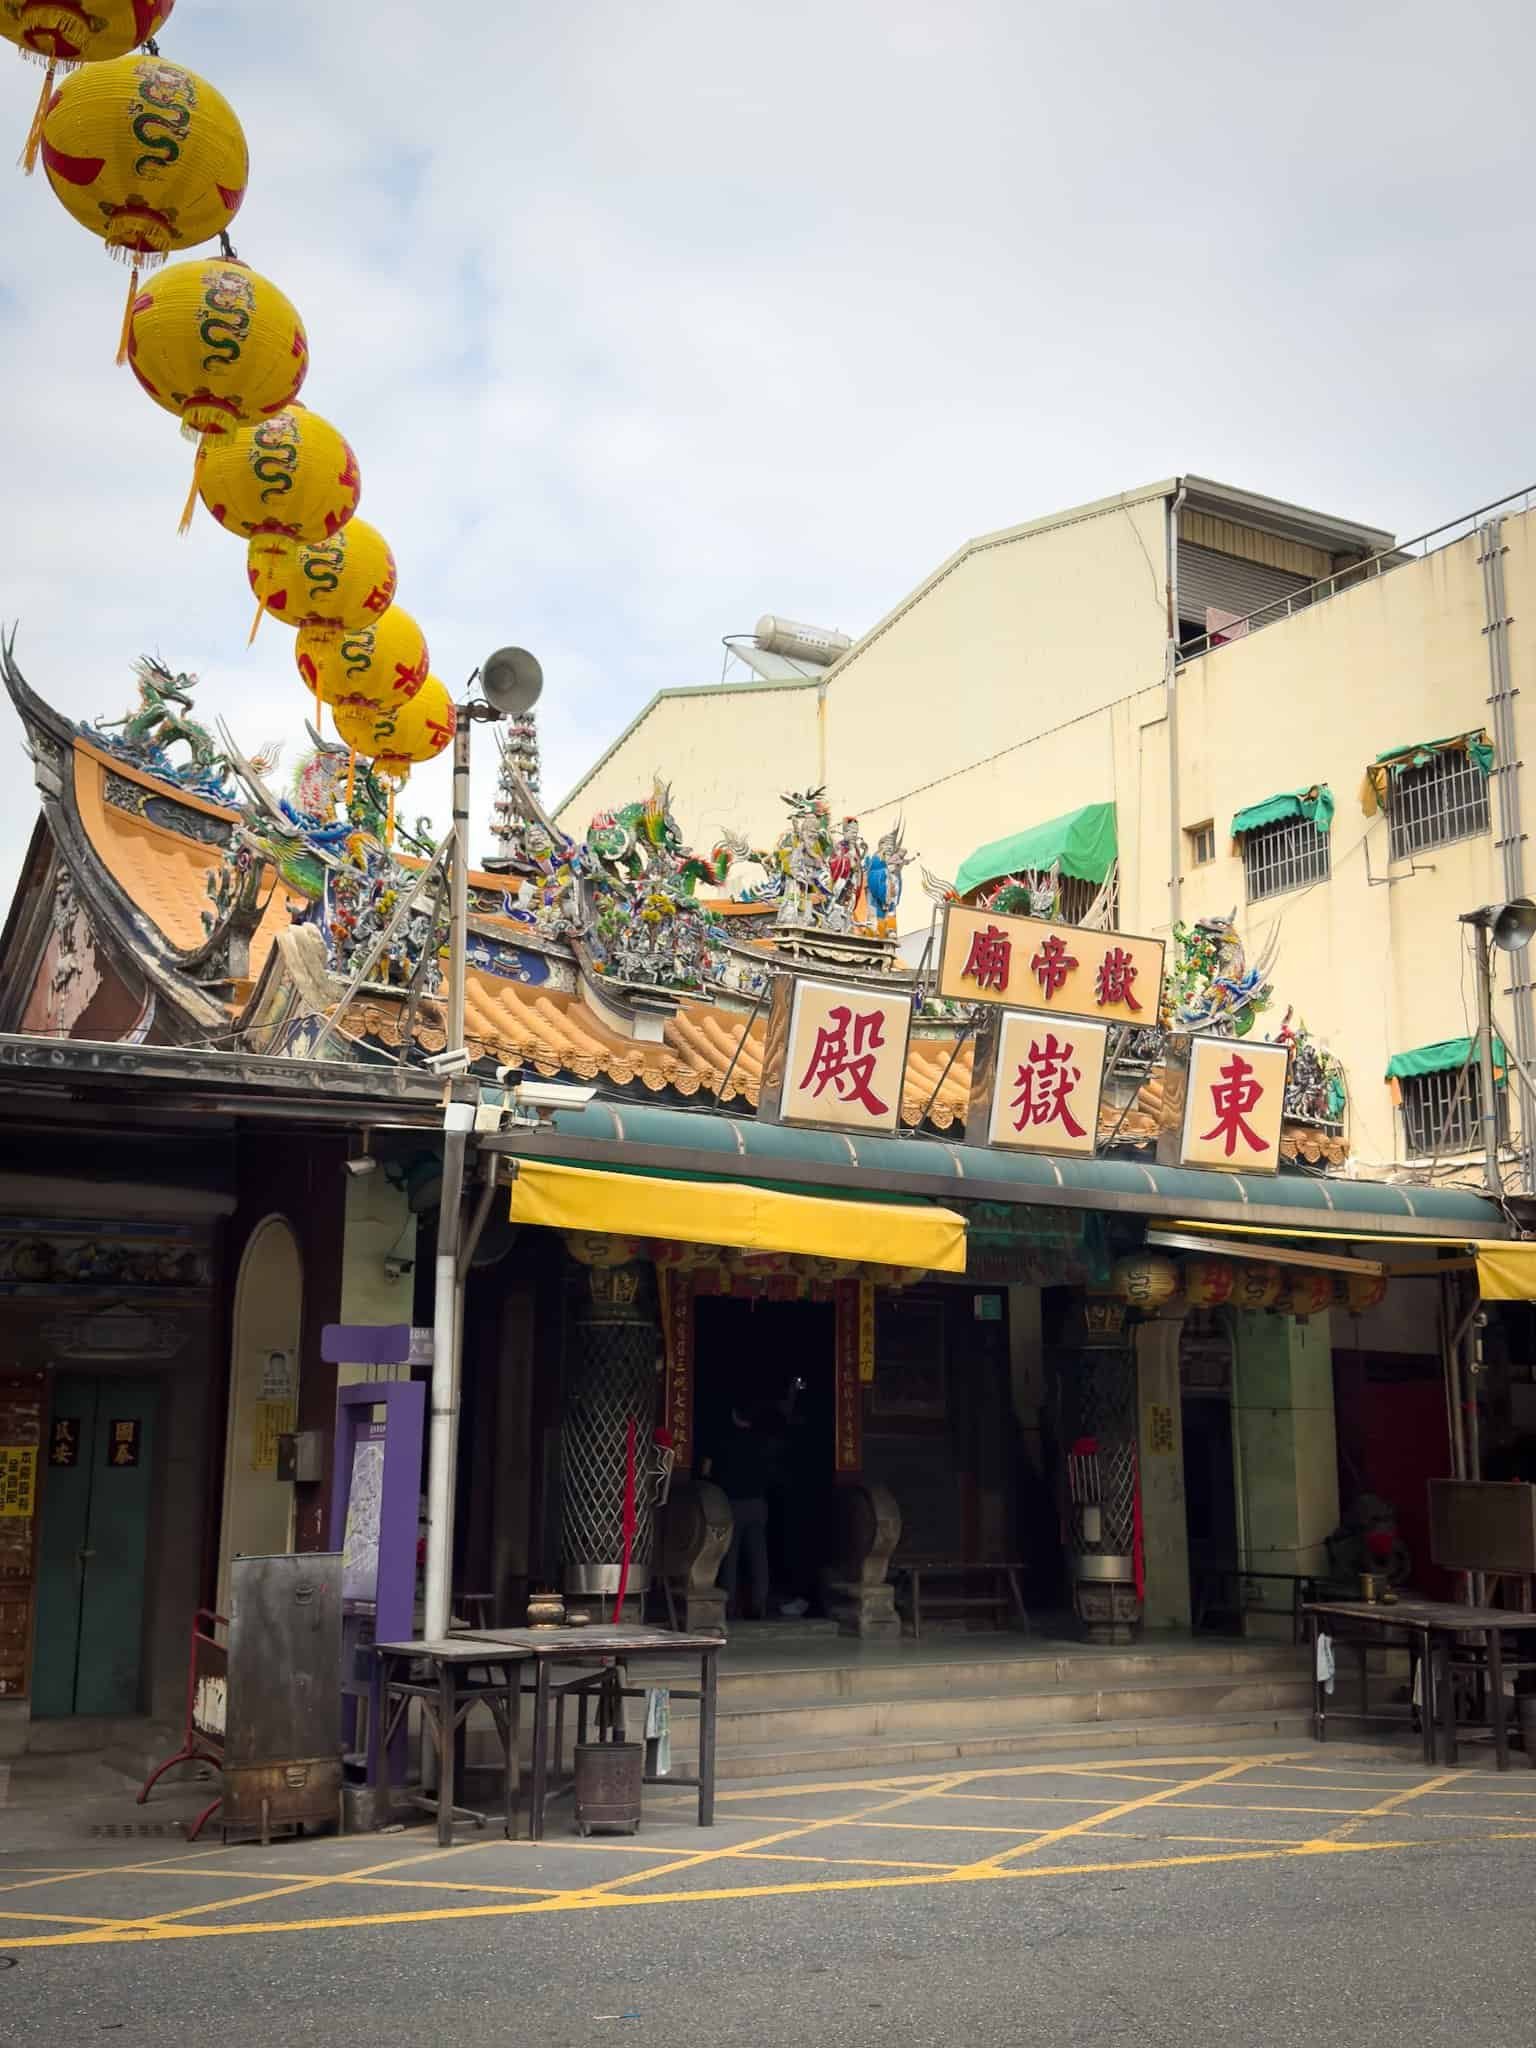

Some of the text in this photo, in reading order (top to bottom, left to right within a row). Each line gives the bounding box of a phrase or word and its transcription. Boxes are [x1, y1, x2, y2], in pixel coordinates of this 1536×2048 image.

[799, 1005, 1270, 1157] 東 嶽 殿
